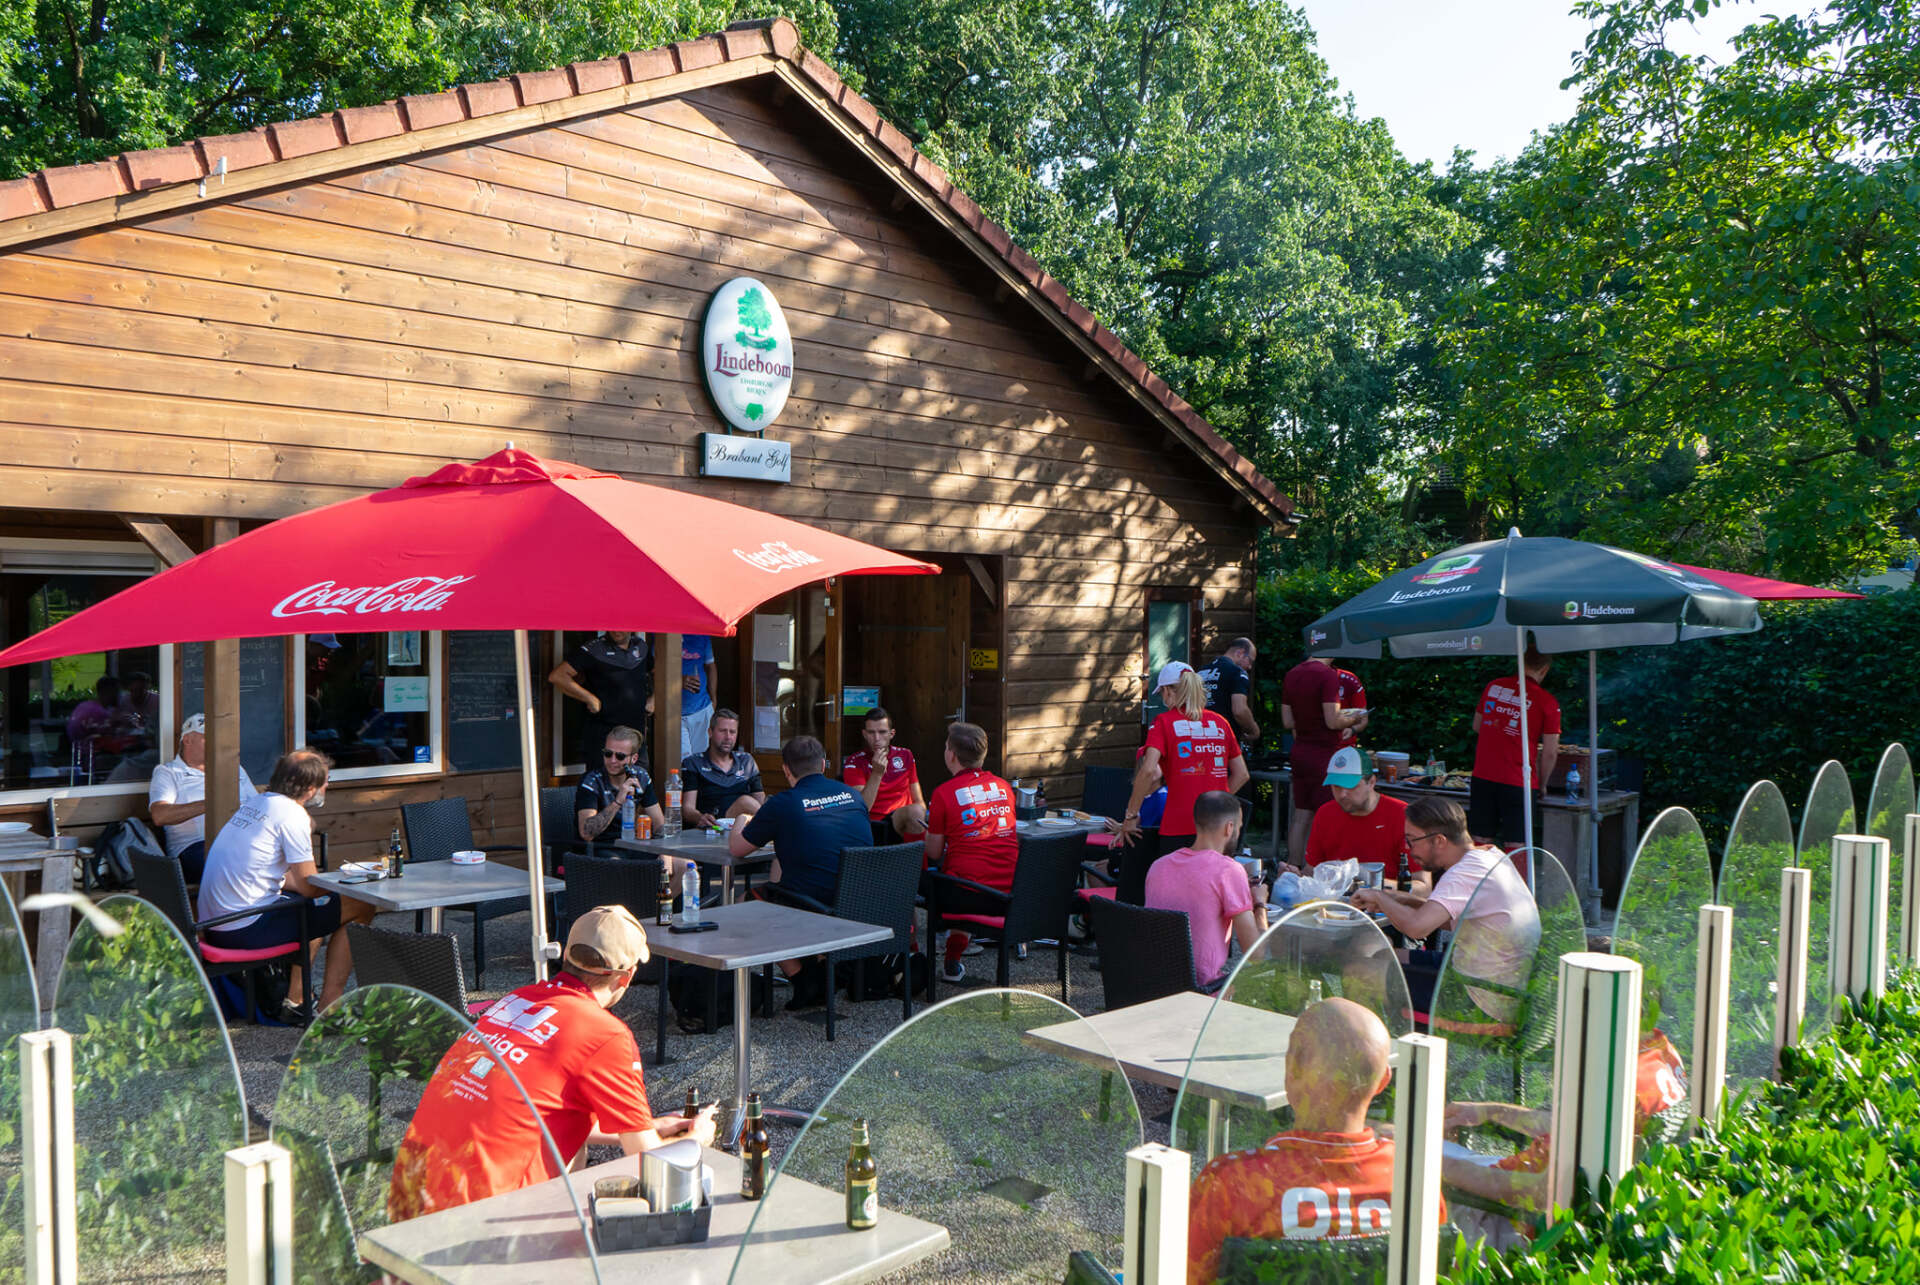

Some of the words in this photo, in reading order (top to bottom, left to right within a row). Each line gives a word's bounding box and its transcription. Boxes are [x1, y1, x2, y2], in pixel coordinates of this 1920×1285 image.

[712, 343, 791, 378] Lindeboom
[709, 443, 763, 464] Brabant
[764, 447, 790, 472] Golf
[1384, 585, 1472, 604] Lindeboom
[1582, 601, 1635, 619] Lindeboom
[802, 791, 852, 808] Panasonic
